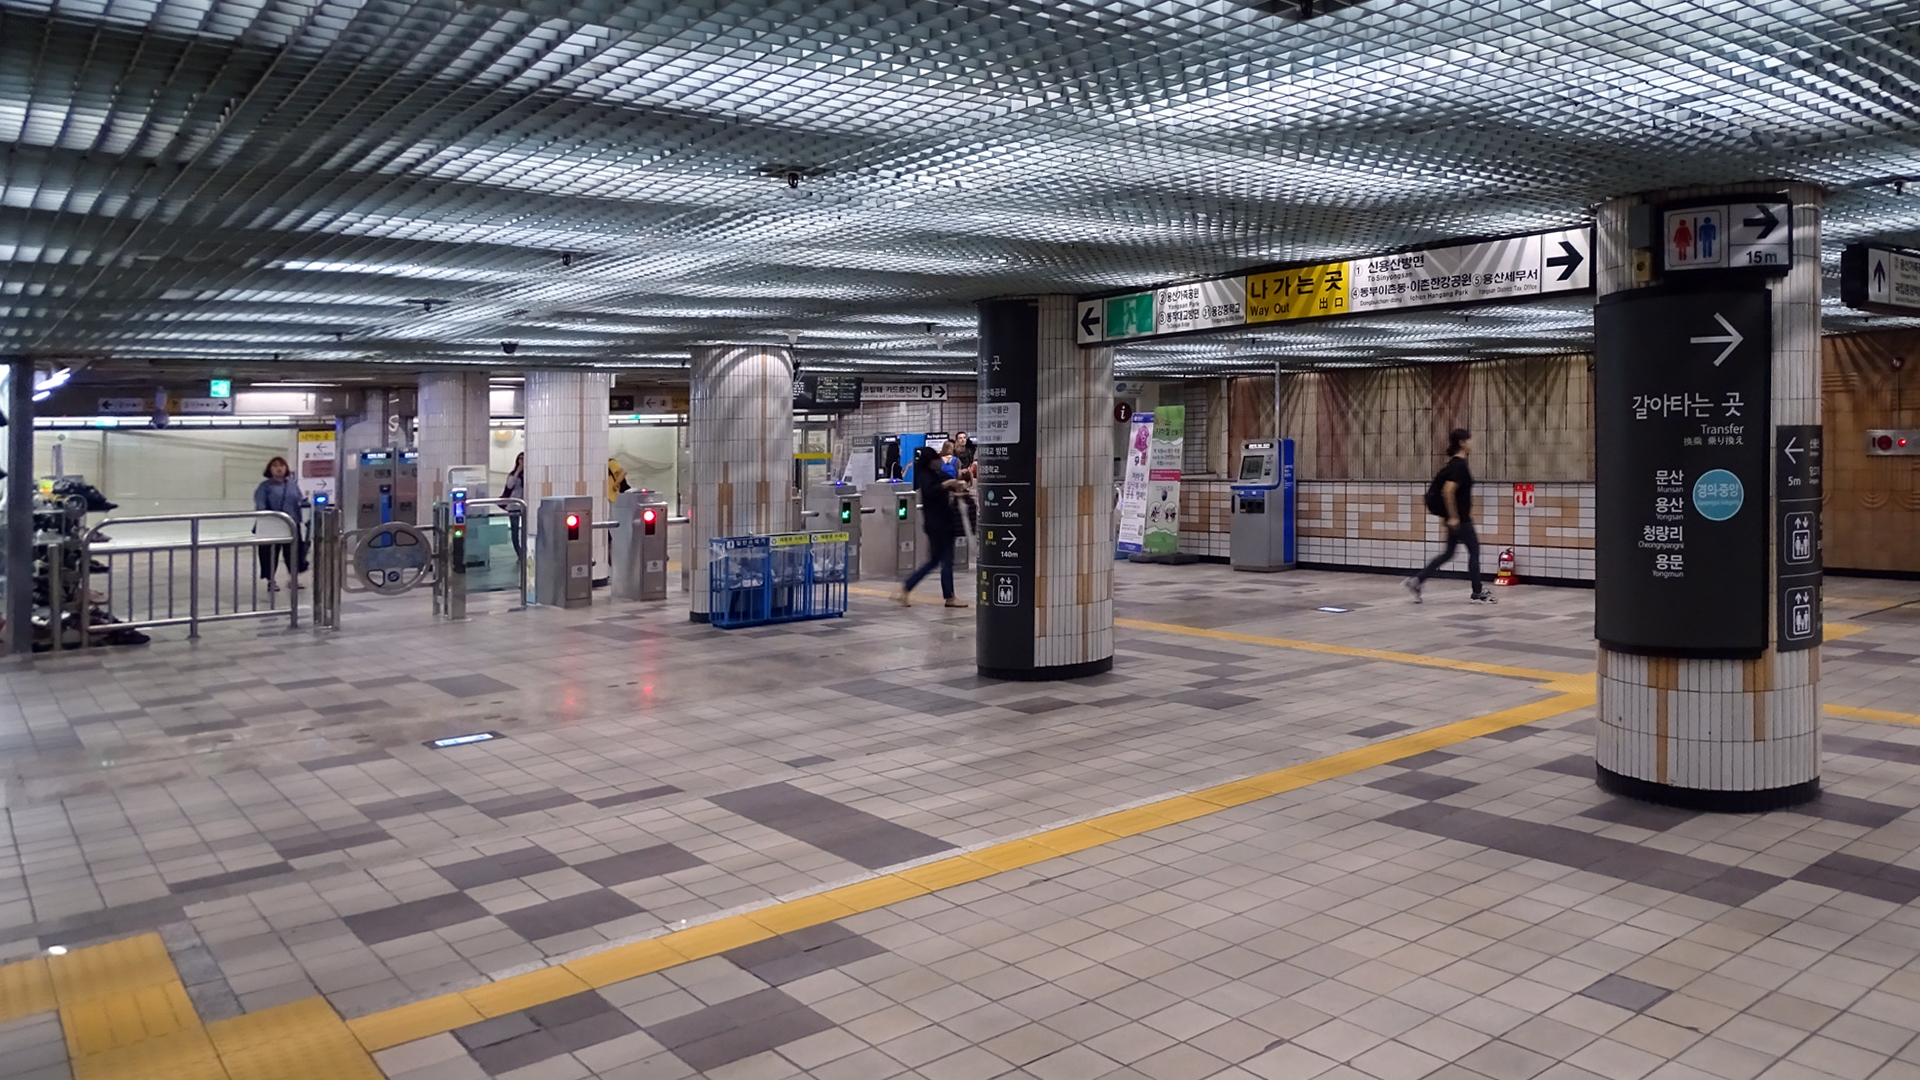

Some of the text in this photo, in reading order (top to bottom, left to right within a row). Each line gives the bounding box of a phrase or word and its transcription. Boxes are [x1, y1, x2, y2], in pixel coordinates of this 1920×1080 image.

[1368, 255, 1424, 273] 신용산방면
[1746, 251, 1777, 264] 15m
[1251, 270, 1343, 299] 나가는 곳
[1483, 269, 1538, 285] 용산세무서
[1250, 303, 1290, 316] Way Out
[1632, 392, 1744, 419] 갈아타는 곳
[1701, 422, 1744, 434] Transfer
[1655, 470, 1684, 485] 문산
[1788, 476, 1801, 486] 5m
[1655, 497, 1684, 513] 용산
[1656, 513, 1684, 521] Yongsan
[1643, 526, 1683, 541] 청량리
[1638, 541, 1684, 549] Cheongnyangni
[1655, 554, 1684, 570] 용문
[1652, 570, 1684, 578] Yongmun
